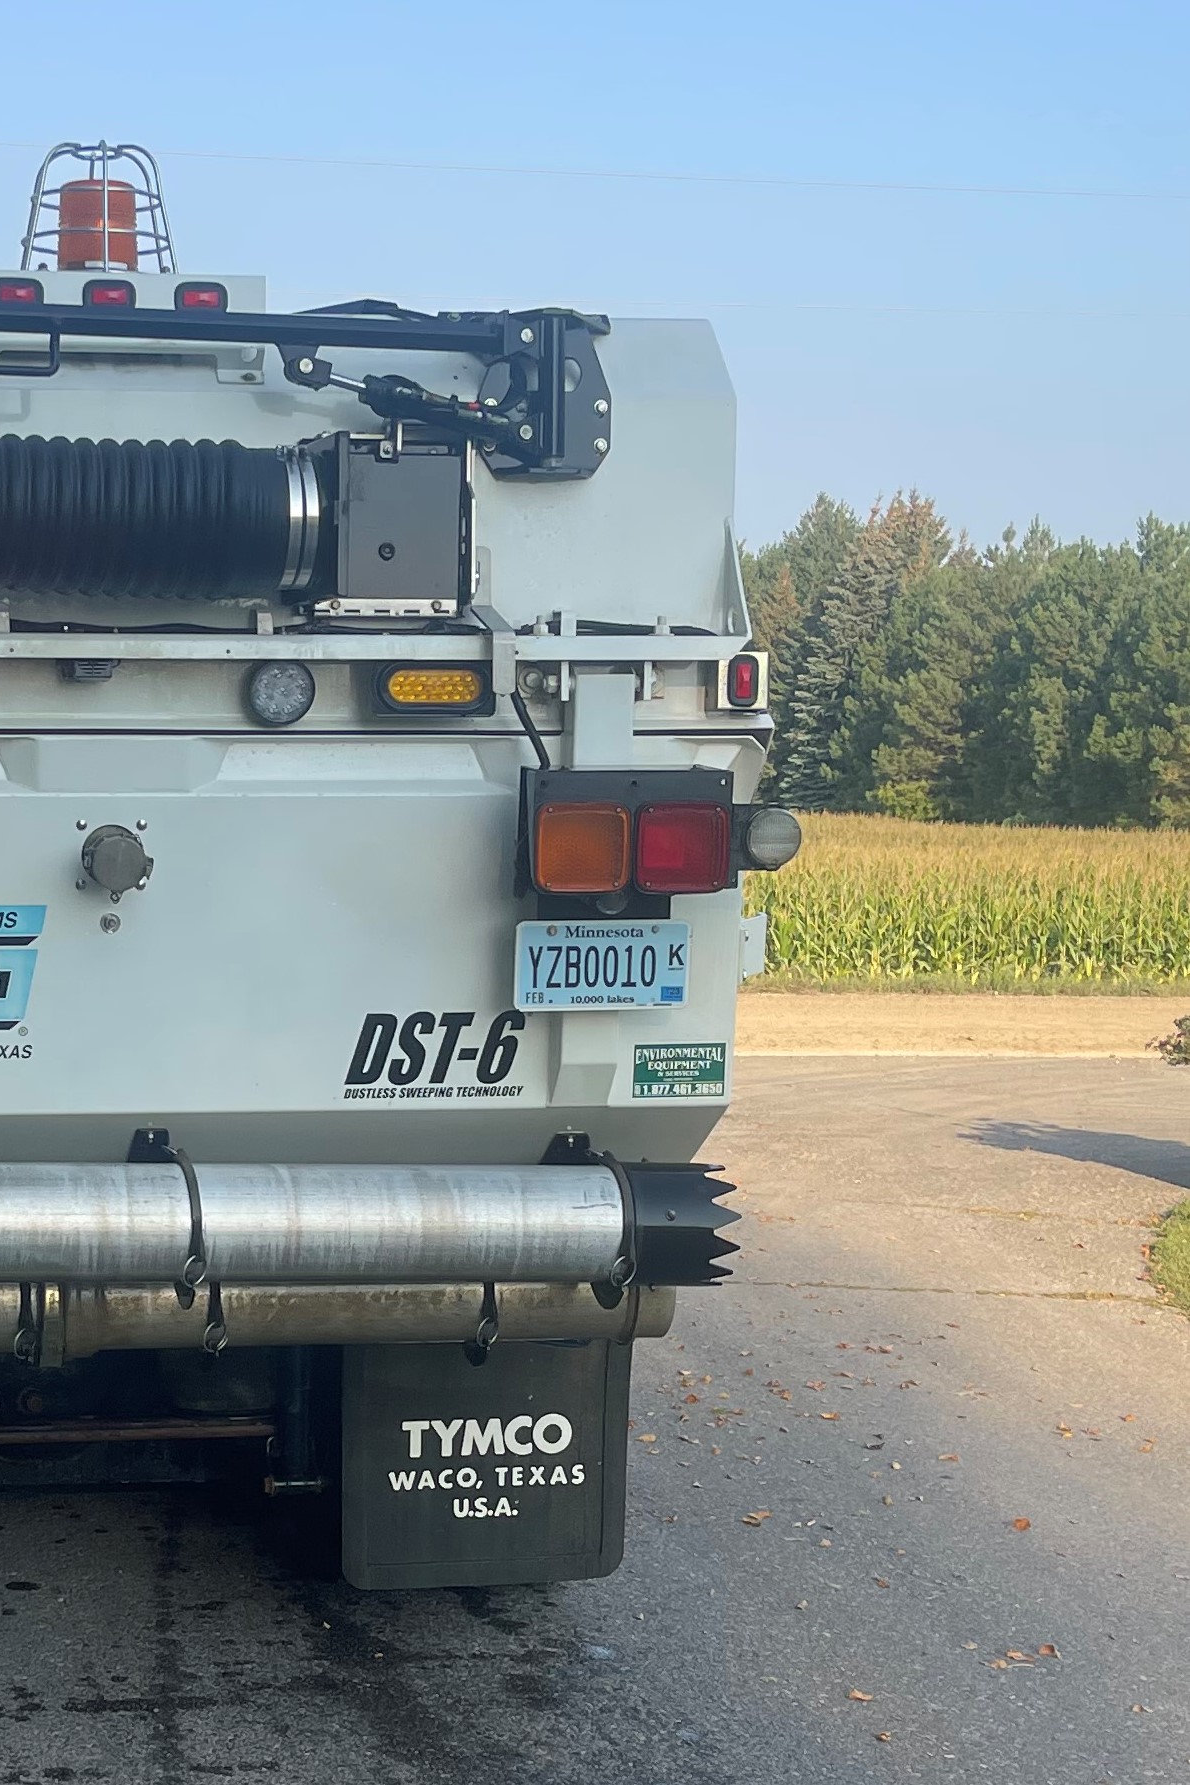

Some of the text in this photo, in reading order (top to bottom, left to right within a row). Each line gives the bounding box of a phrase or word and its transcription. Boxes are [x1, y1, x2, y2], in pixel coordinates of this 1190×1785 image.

[564, 926, 644, 938] Minnesota
[528, 943, 685, 989] YZB0010 K
[344, 1010, 526, 1086] DST-6
[635, 1046, 724, 1065] ENVIRONMENTAL
[647, 1060, 712, 1071] EQUIPMENT
[344, 1085, 524, 1099] DUSTLESS SWEEPING TECHNOLOGY
[401, 1413, 573, 1459] TYMCO
[388, 1464, 586, 1491] WACO, TEXAS
[453, 1497, 519, 1518] U.S.A.
